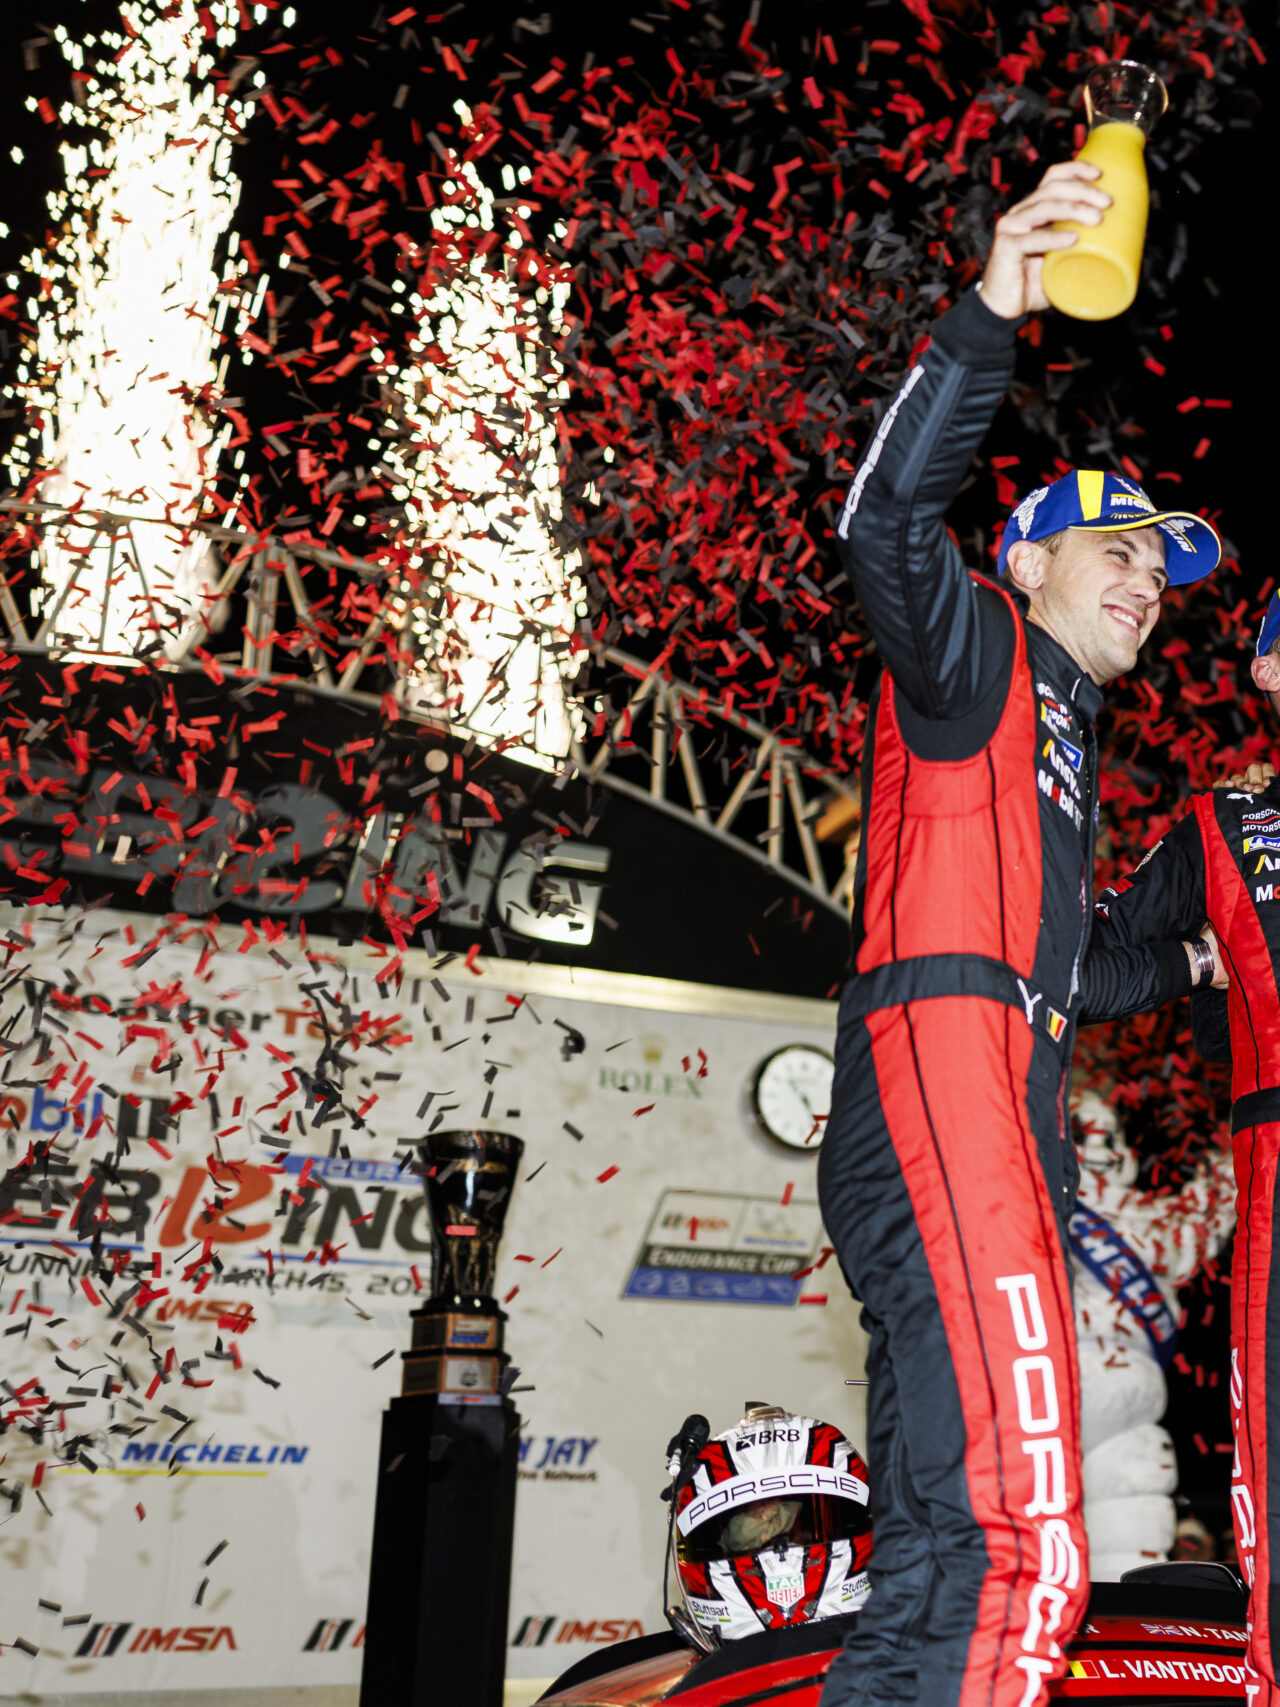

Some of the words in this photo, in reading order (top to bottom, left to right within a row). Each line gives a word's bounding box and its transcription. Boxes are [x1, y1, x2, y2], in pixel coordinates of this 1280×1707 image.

[759, 1428, 800, 1445] BRB
[122, 1441, 309, 1464] MICHELIN
[688, 1473, 859, 1525] PORSCHE
[128, 1625, 238, 1652] IMSA
[555, 1619, 645, 1643] IMSA
[1099, 1660, 1126, 1679] L.
